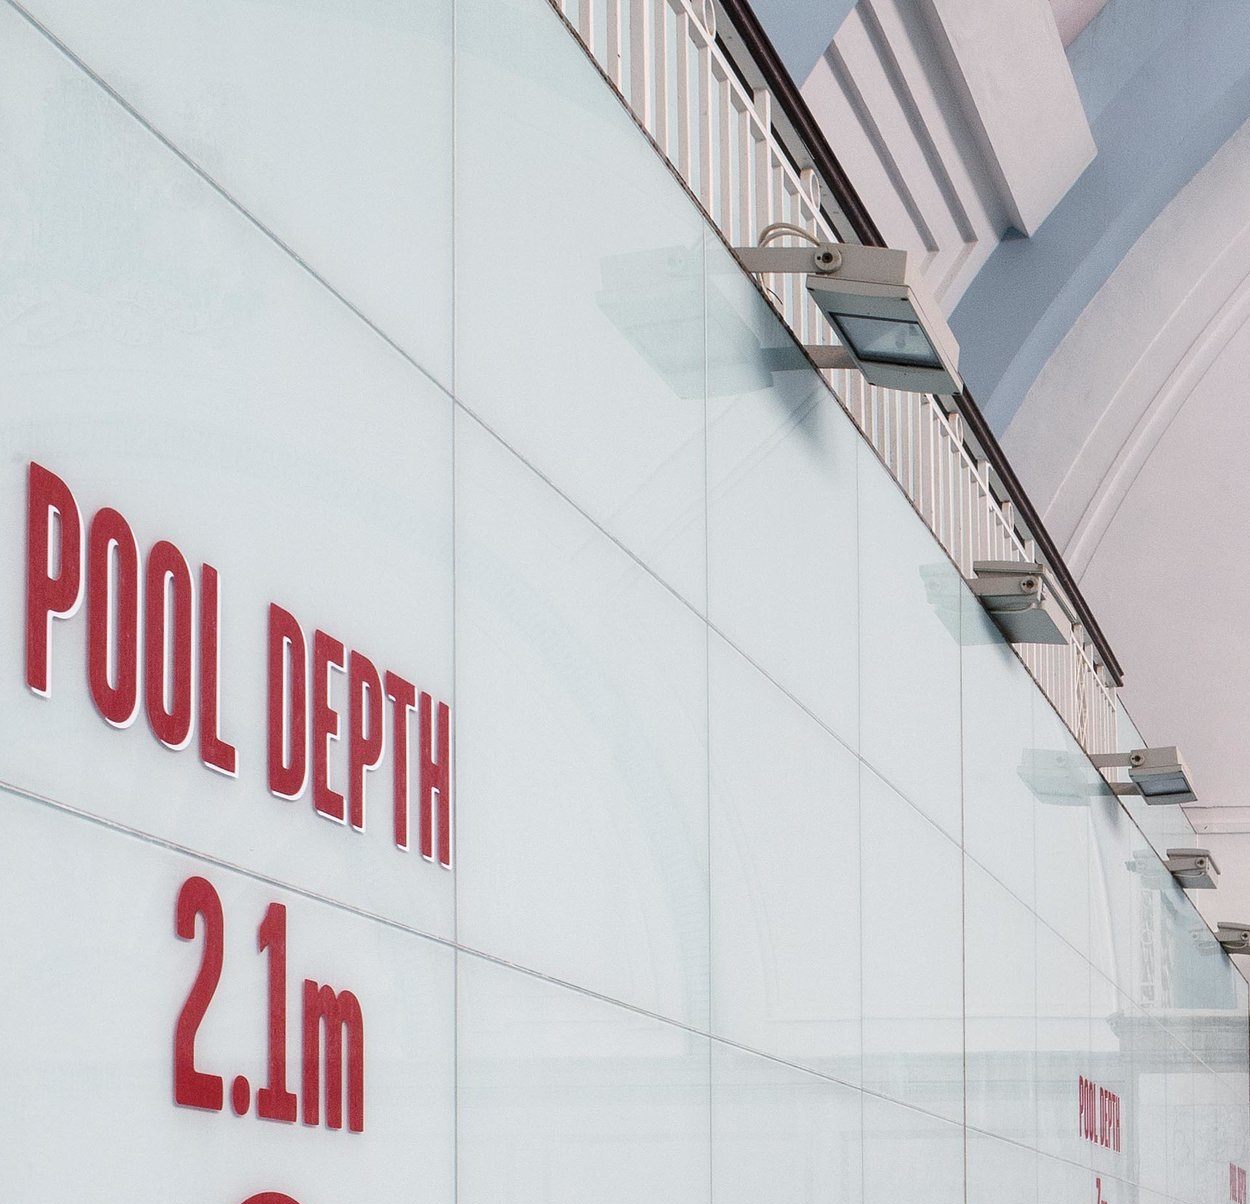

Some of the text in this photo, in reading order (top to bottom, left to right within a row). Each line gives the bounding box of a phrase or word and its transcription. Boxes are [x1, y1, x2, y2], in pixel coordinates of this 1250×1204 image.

[25, 460, 453, 870] POOL DEPTH
[173, 875, 364, 1133] 2.1m
[1079, 1075, 1121, 1153] POOL DEPTH
